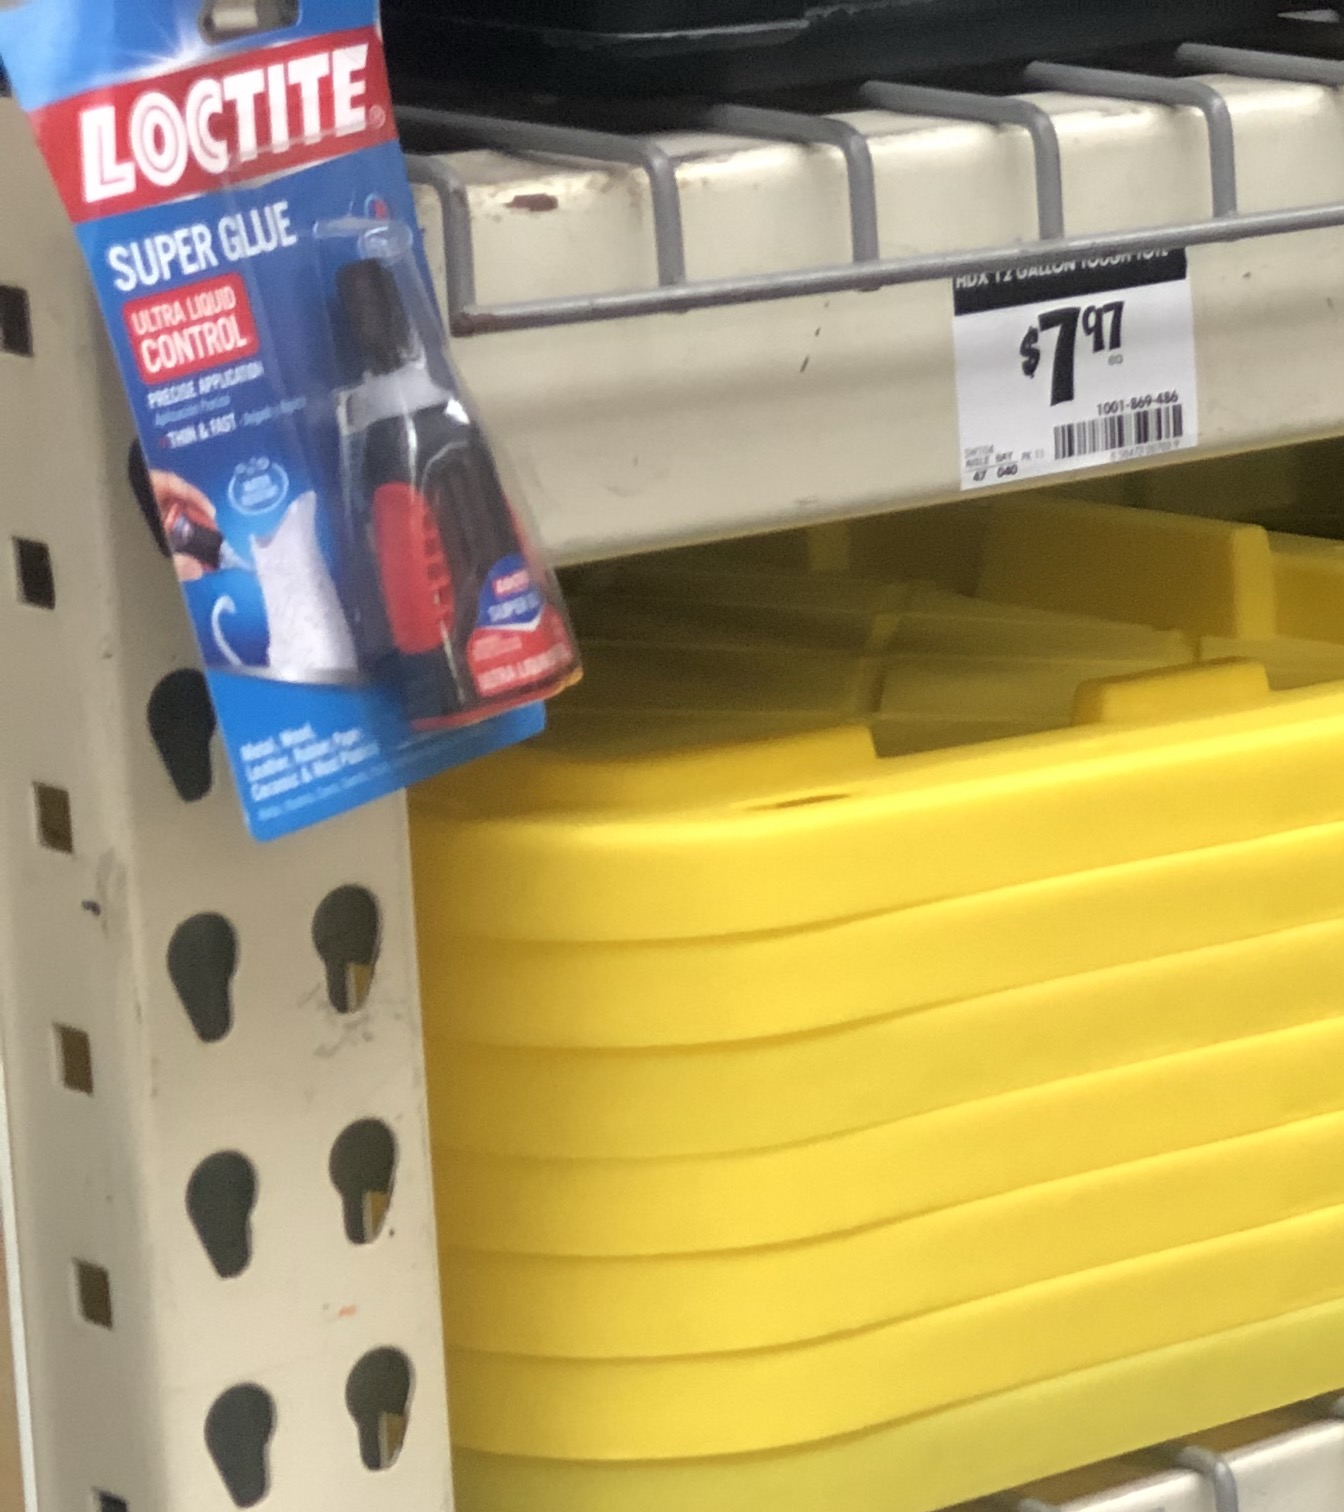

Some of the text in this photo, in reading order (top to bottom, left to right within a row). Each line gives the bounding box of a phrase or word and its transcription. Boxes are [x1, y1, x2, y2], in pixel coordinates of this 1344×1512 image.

[80, 43, 369, 204] LOCTITE
[108, 200, 298, 292] SUPER GLUE
[131, 286, 237, 336] ULTRA LIQUID
[141, 315, 247, 374] CONTROL
